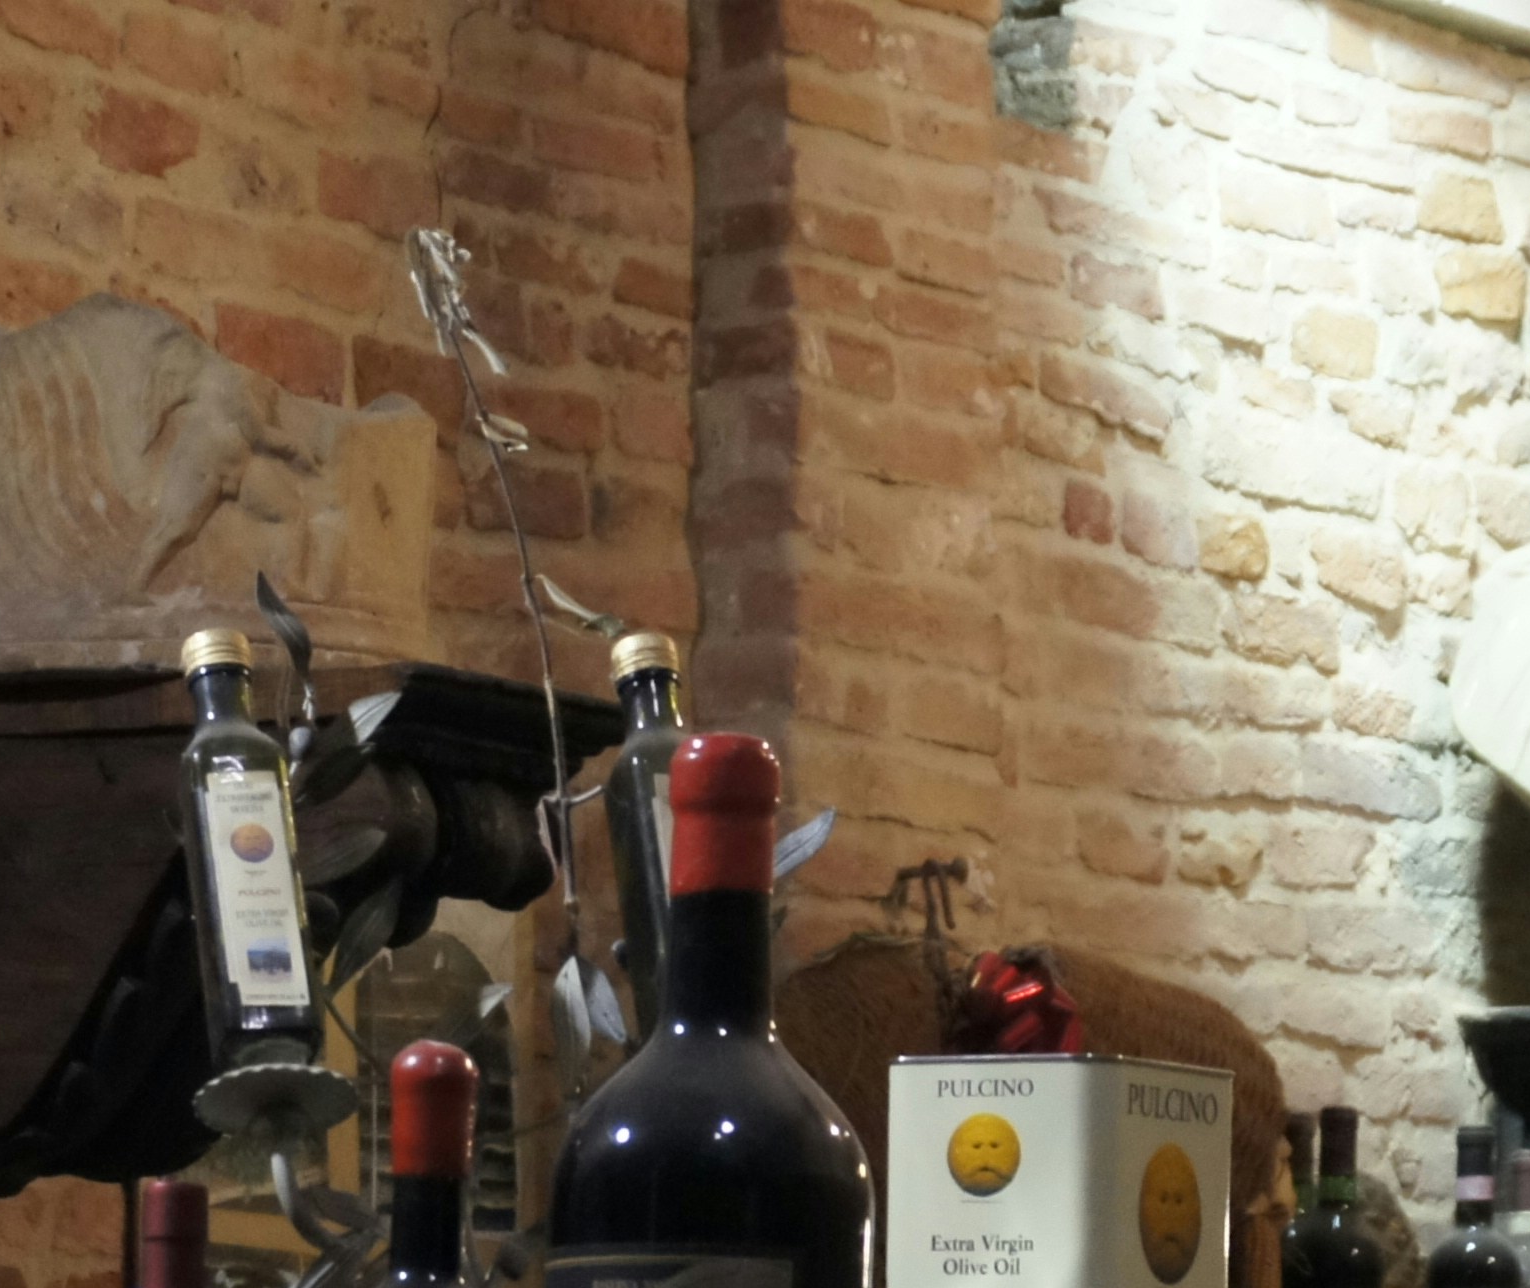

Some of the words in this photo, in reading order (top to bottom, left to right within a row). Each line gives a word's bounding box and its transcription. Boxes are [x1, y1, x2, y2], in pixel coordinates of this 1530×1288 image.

[936, 1078, 1034, 1098] PULCINO
[1126, 1083, 1218, 1125] PULCINO
[930, 1235, 975, 1253] Extra
[982, 1234, 1034, 1256] Virgin
[942, 1258, 988, 1276] Olive
[994, 1258, 1021, 1276] Oil
